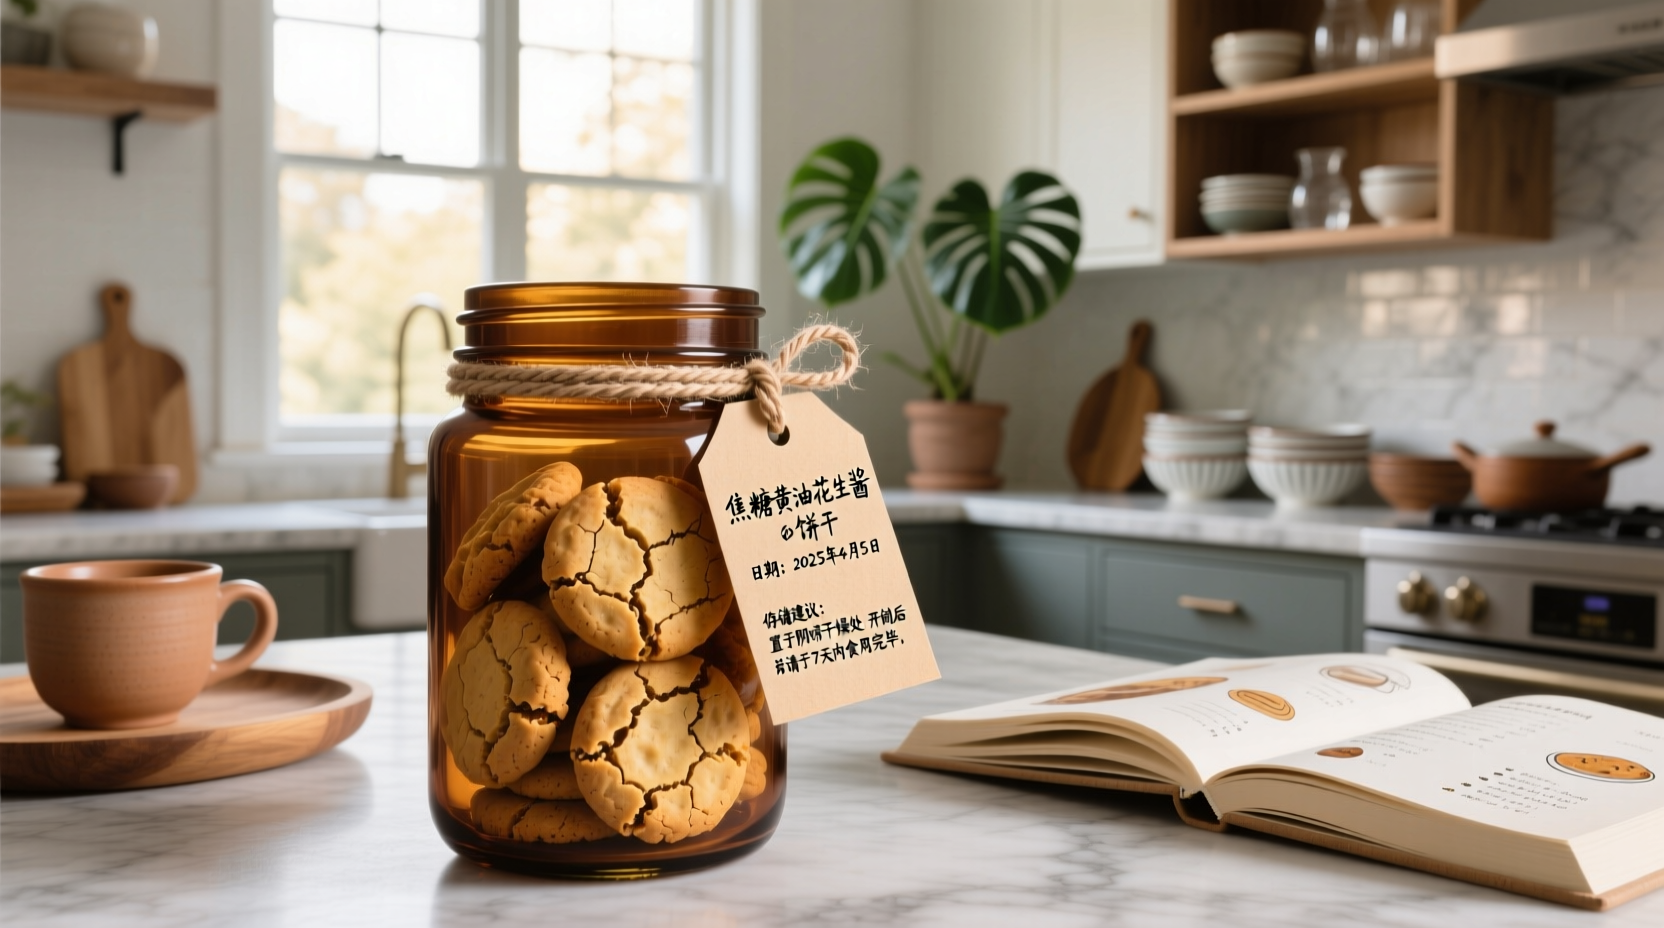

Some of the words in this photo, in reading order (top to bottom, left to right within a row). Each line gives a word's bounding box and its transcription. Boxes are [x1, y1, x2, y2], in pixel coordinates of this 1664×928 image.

[726, 467, 869, 524] 焦糖黄油花生酱
[794, 539, 879, 570] 2025年4月5日
